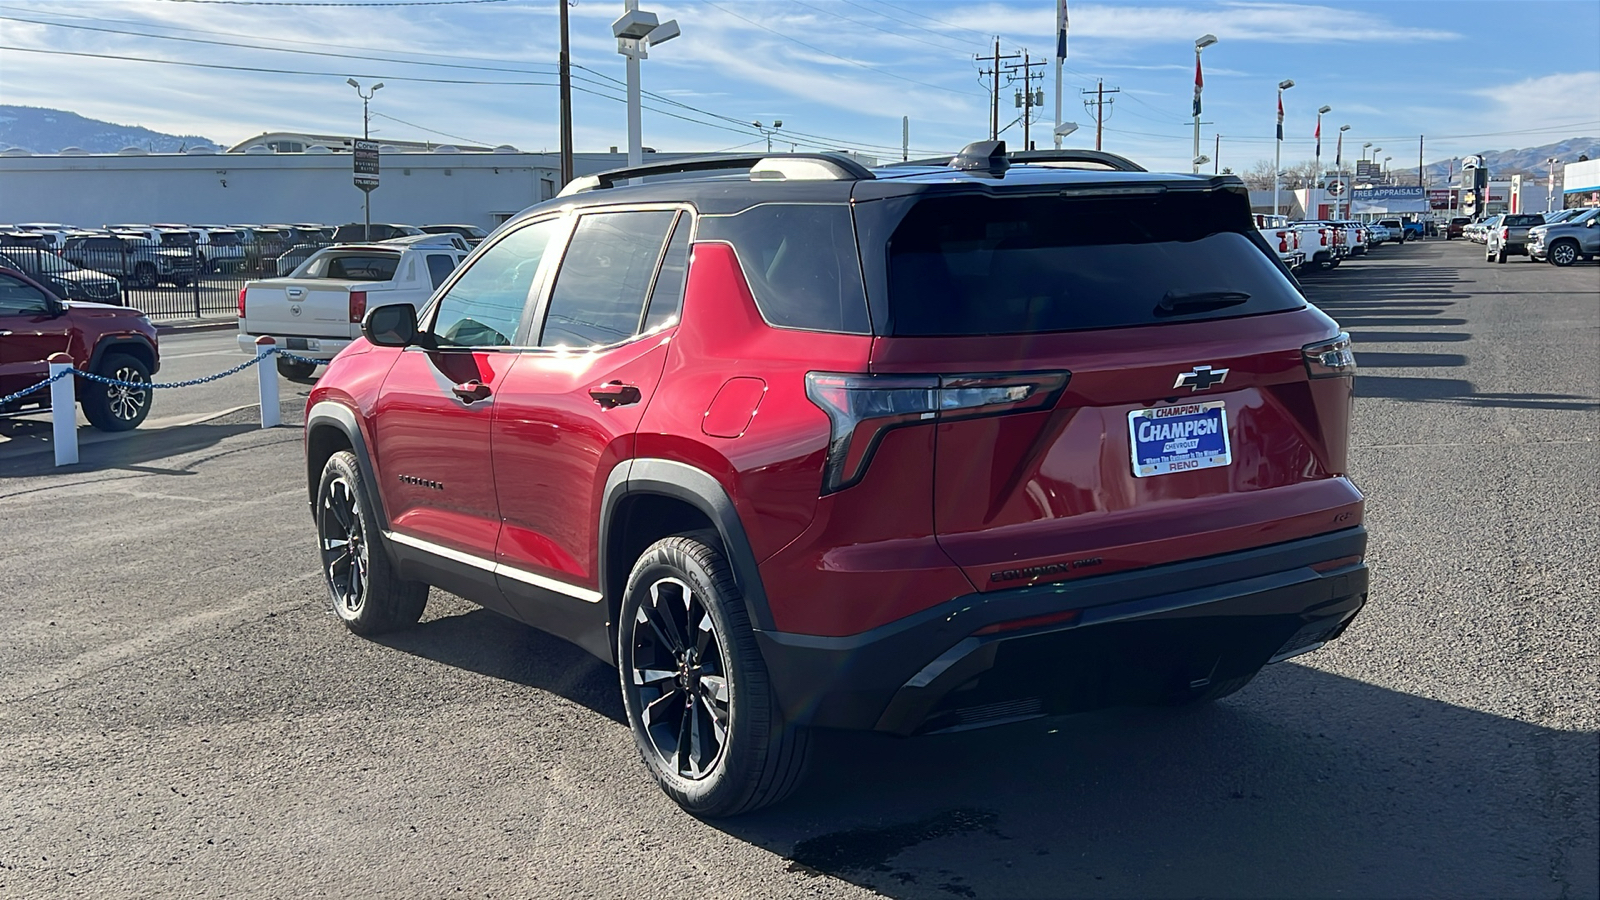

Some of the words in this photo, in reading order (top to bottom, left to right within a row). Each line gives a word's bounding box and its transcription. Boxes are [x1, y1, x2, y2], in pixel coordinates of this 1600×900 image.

[357, 142, 379, 150] Corwin
[356, 151, 379, 159] GMC
[1374, 188, 1423, 196] APPRAISALS!
[1156, 405, 1200, 417] CHAMPION
[1138, 418, 1218, 443] CHAMPION
[1165, 440, 1197, 450] CHEVROLET
[1169, 460, 1199, 471] RENO
[990, 563, 1069, 582] EQUINOX
